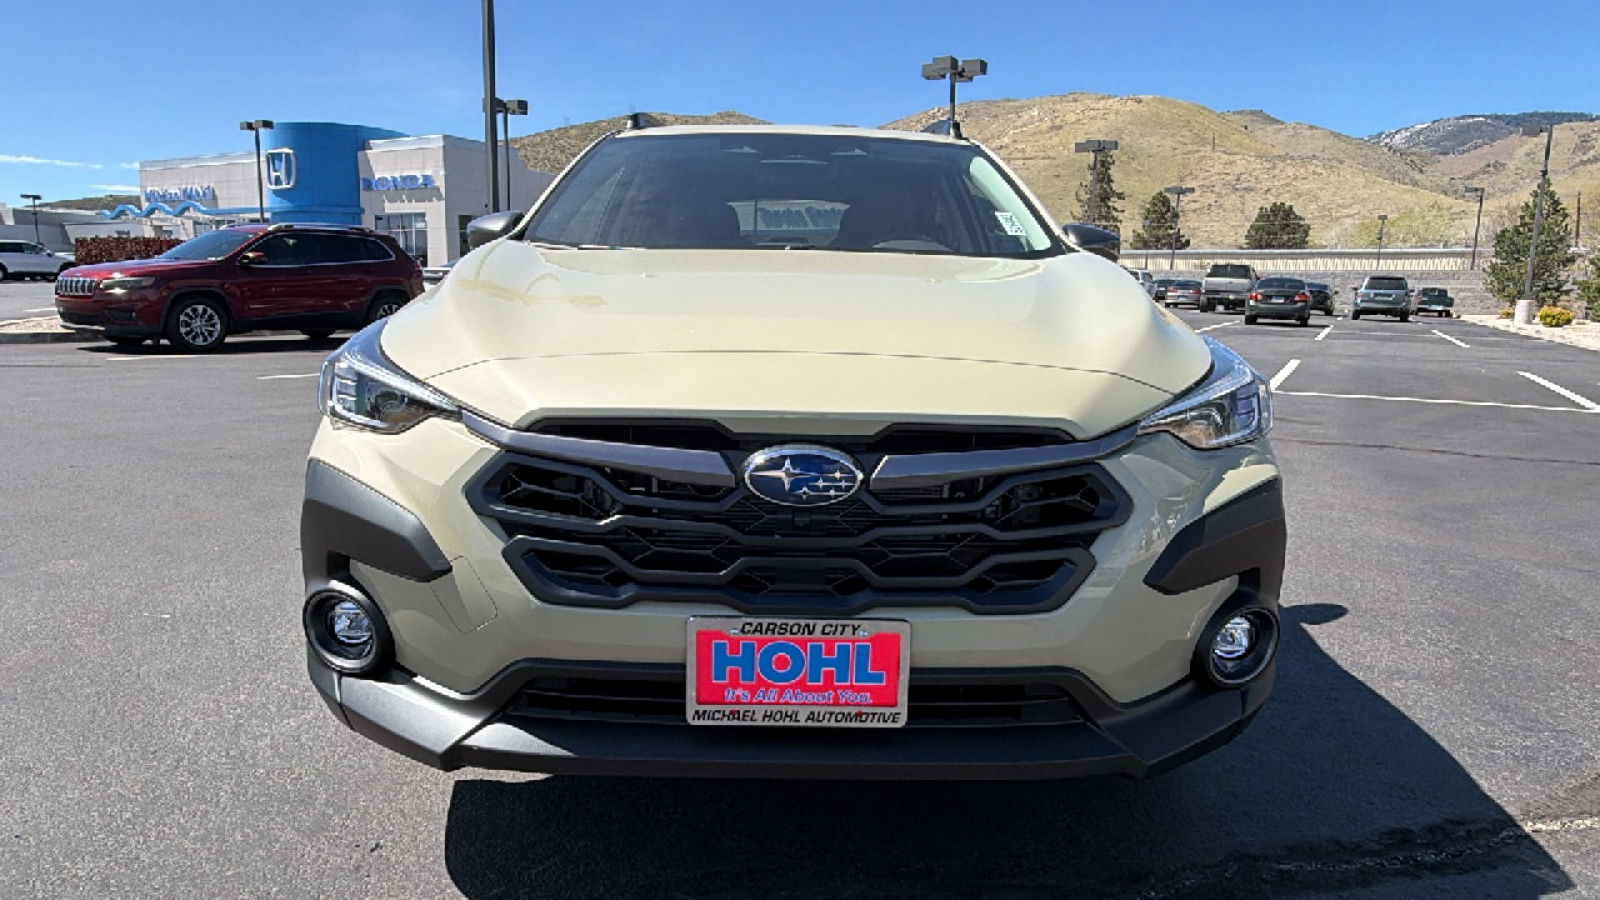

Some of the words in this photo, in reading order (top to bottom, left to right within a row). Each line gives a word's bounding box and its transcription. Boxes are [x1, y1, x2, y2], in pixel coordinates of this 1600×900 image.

[361, 174, 435, 191] HONDA
[740, 621, 816, 635] CARSON
[820, 623, 861, 636] CITY
[712, 640, 885, 685] HOHL
[724, 687, 750, 702] It's
[753, 687, 780, 702] All
[779, 688, 834, 704] About
[837, 689, 873, 704] You.
[692, 709, 758, 722] MICHAEL
[762, 709, 800, 722] HOHL
[804, 711, 901, 723] AUTOMOTIVE
